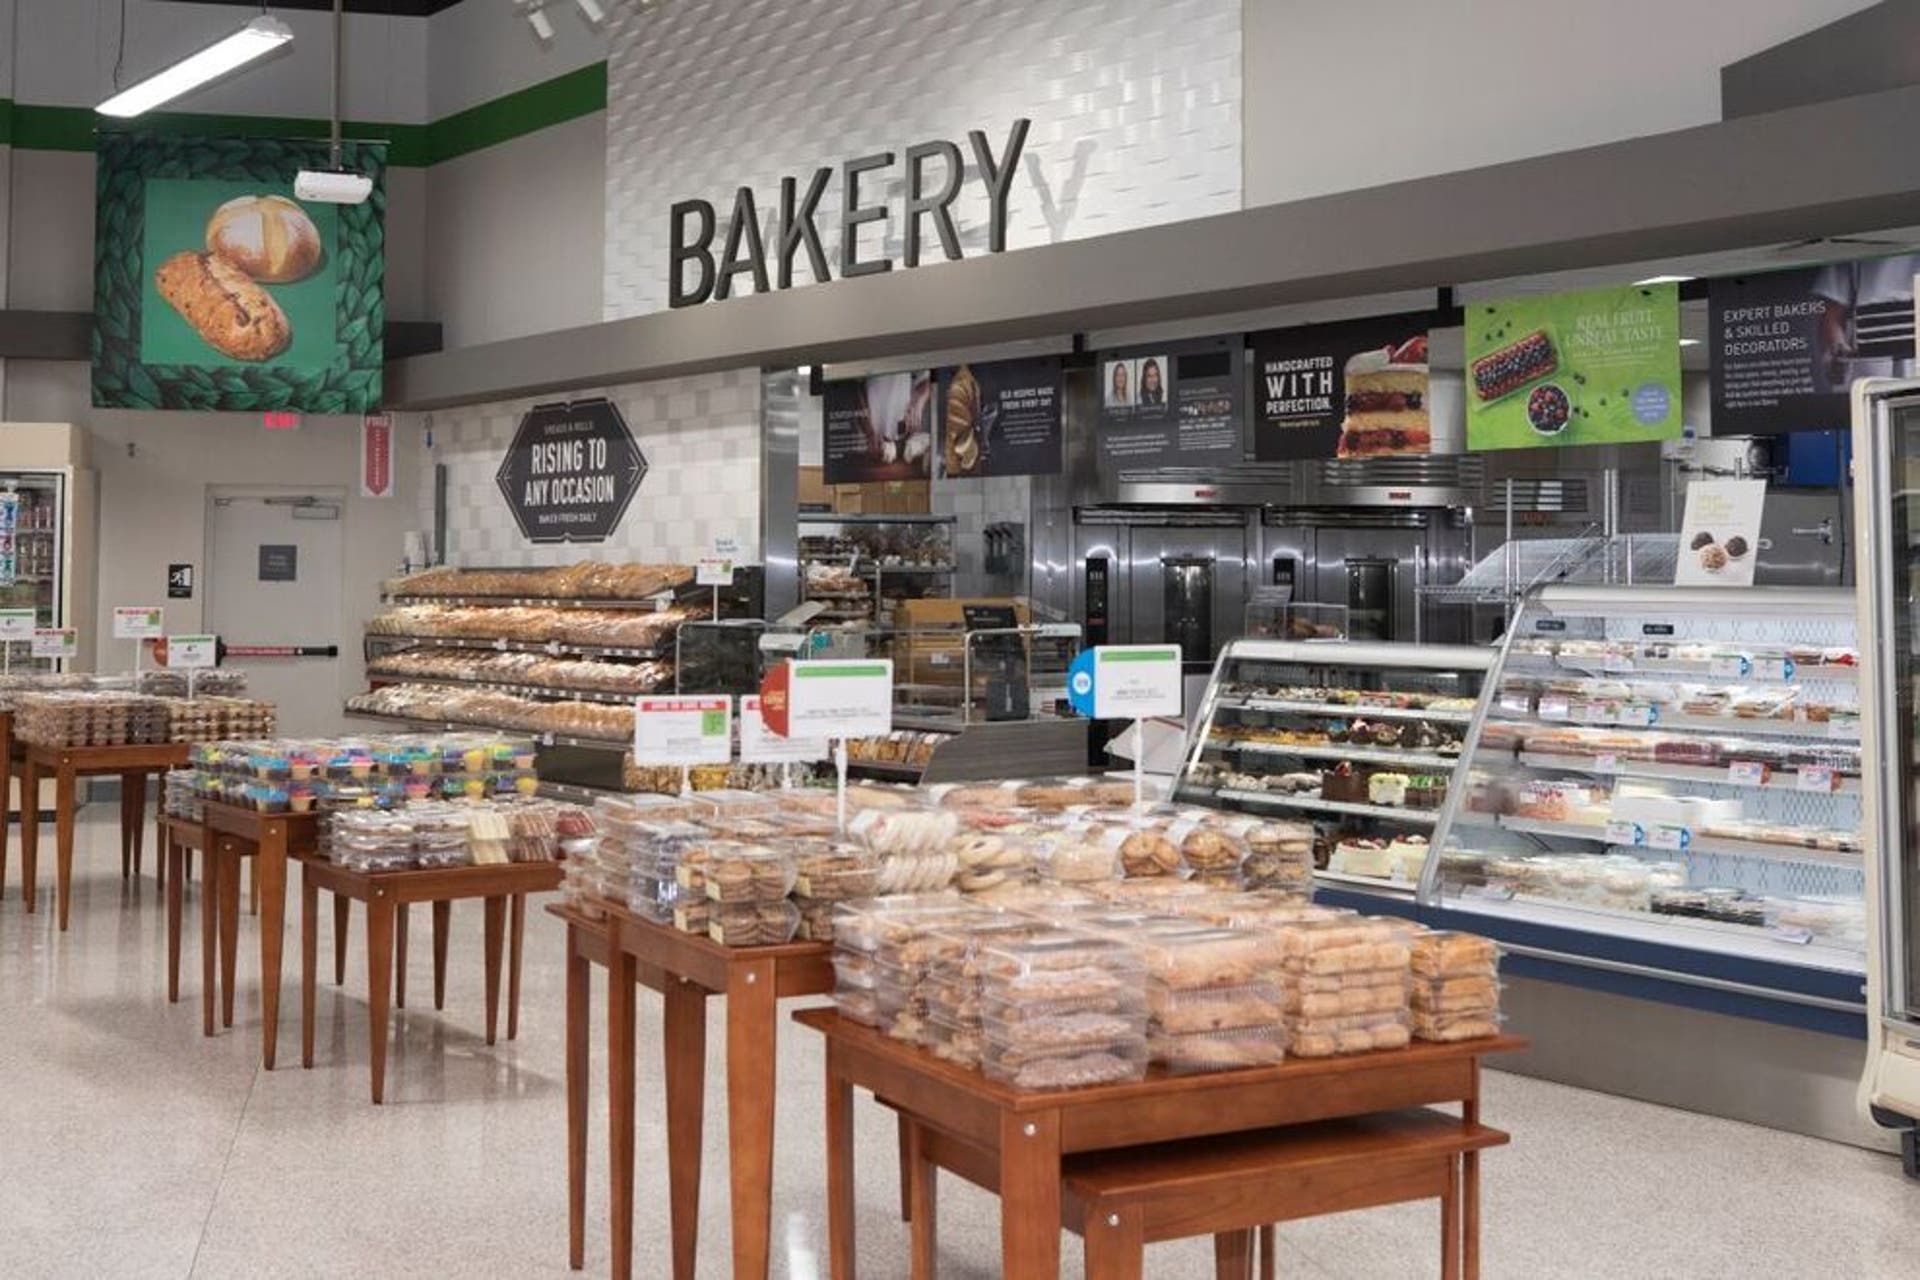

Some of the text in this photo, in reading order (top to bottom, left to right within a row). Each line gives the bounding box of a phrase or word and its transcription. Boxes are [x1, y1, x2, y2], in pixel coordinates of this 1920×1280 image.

[669, 118, 1031, 309] BAKERY
[1723, 300, 1826, 323] EXPERT BAKERS
[1724, 322, 1790, 340] & SKILLED
[1725, 337, 1808, 355] DECORATORS
[1265, 356, 1333, 374] HANDCRAFTED
[1265, 371, 1333, 399] WITH
[532, 437, 606, 474] RISING TO
[524, 475, 614, 507] ANY OCCASION
